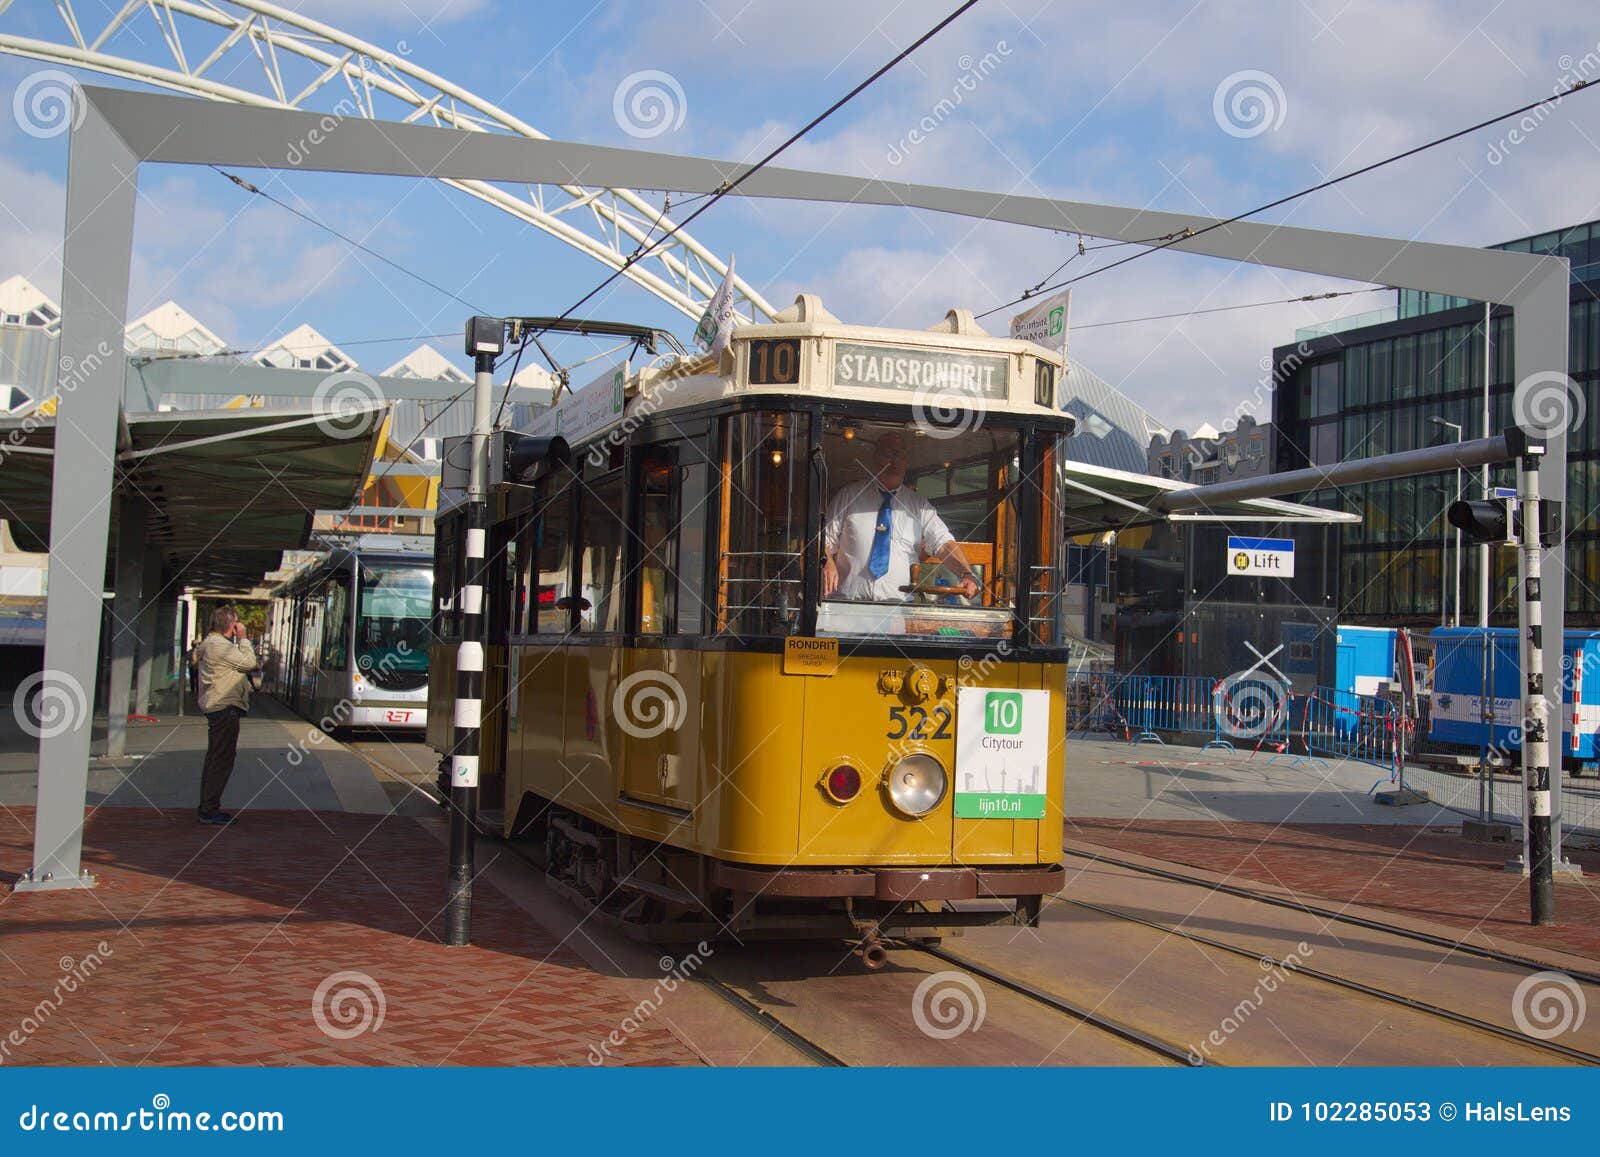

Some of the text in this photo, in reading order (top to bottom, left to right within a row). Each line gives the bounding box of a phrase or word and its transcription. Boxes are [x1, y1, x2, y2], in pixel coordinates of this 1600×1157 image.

[756, 342, 794, 384] 10
[839, 353, 997, 392] STADSRONDRIT
[1254, 553, 1280, 569] Lift
[788, 639, 837, 651] RONDRIT
[384, 711, 413, 723] RET
[988, 699, 1019, 729] 10
[886, 706, 952, 740] 522
[981, 736, 1024, 752] Citytour
[979, 799, 1021, 815] lijn10.nl
